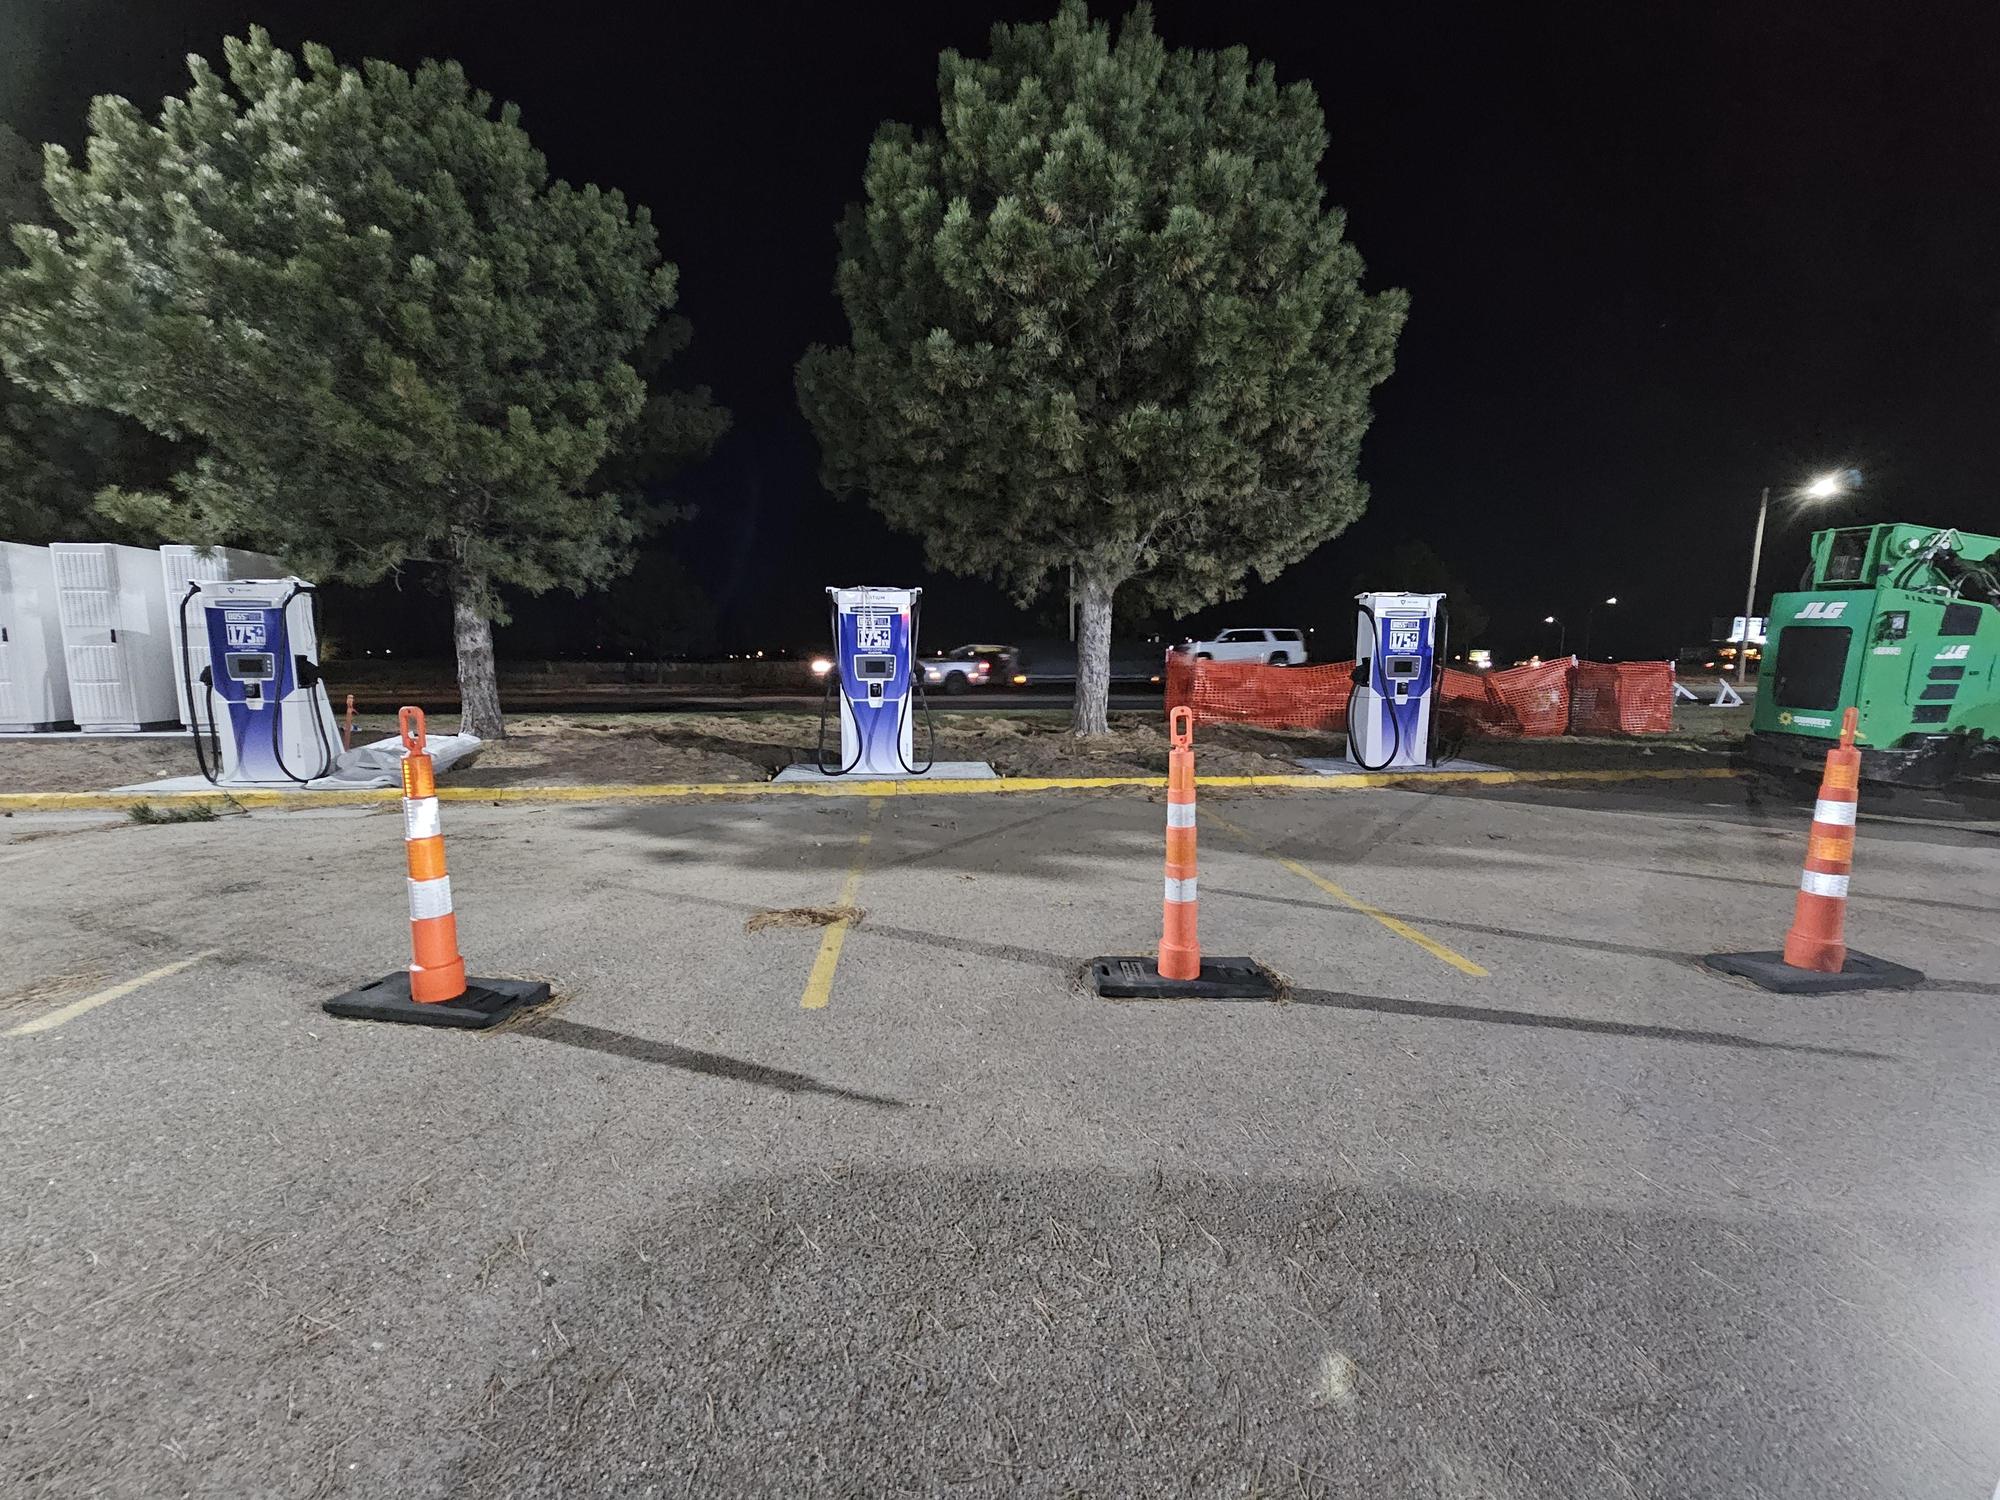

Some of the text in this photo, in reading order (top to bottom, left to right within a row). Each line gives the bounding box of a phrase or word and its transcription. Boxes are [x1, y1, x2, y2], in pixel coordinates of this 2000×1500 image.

[1794, 602, 1848, 618] JLG
[229, 626, 256, 644] 175
[860, 631, 881, 646] 175
[1391, 632, 1411, 649] 175
[1934, 645, 1970, 659] JLG
